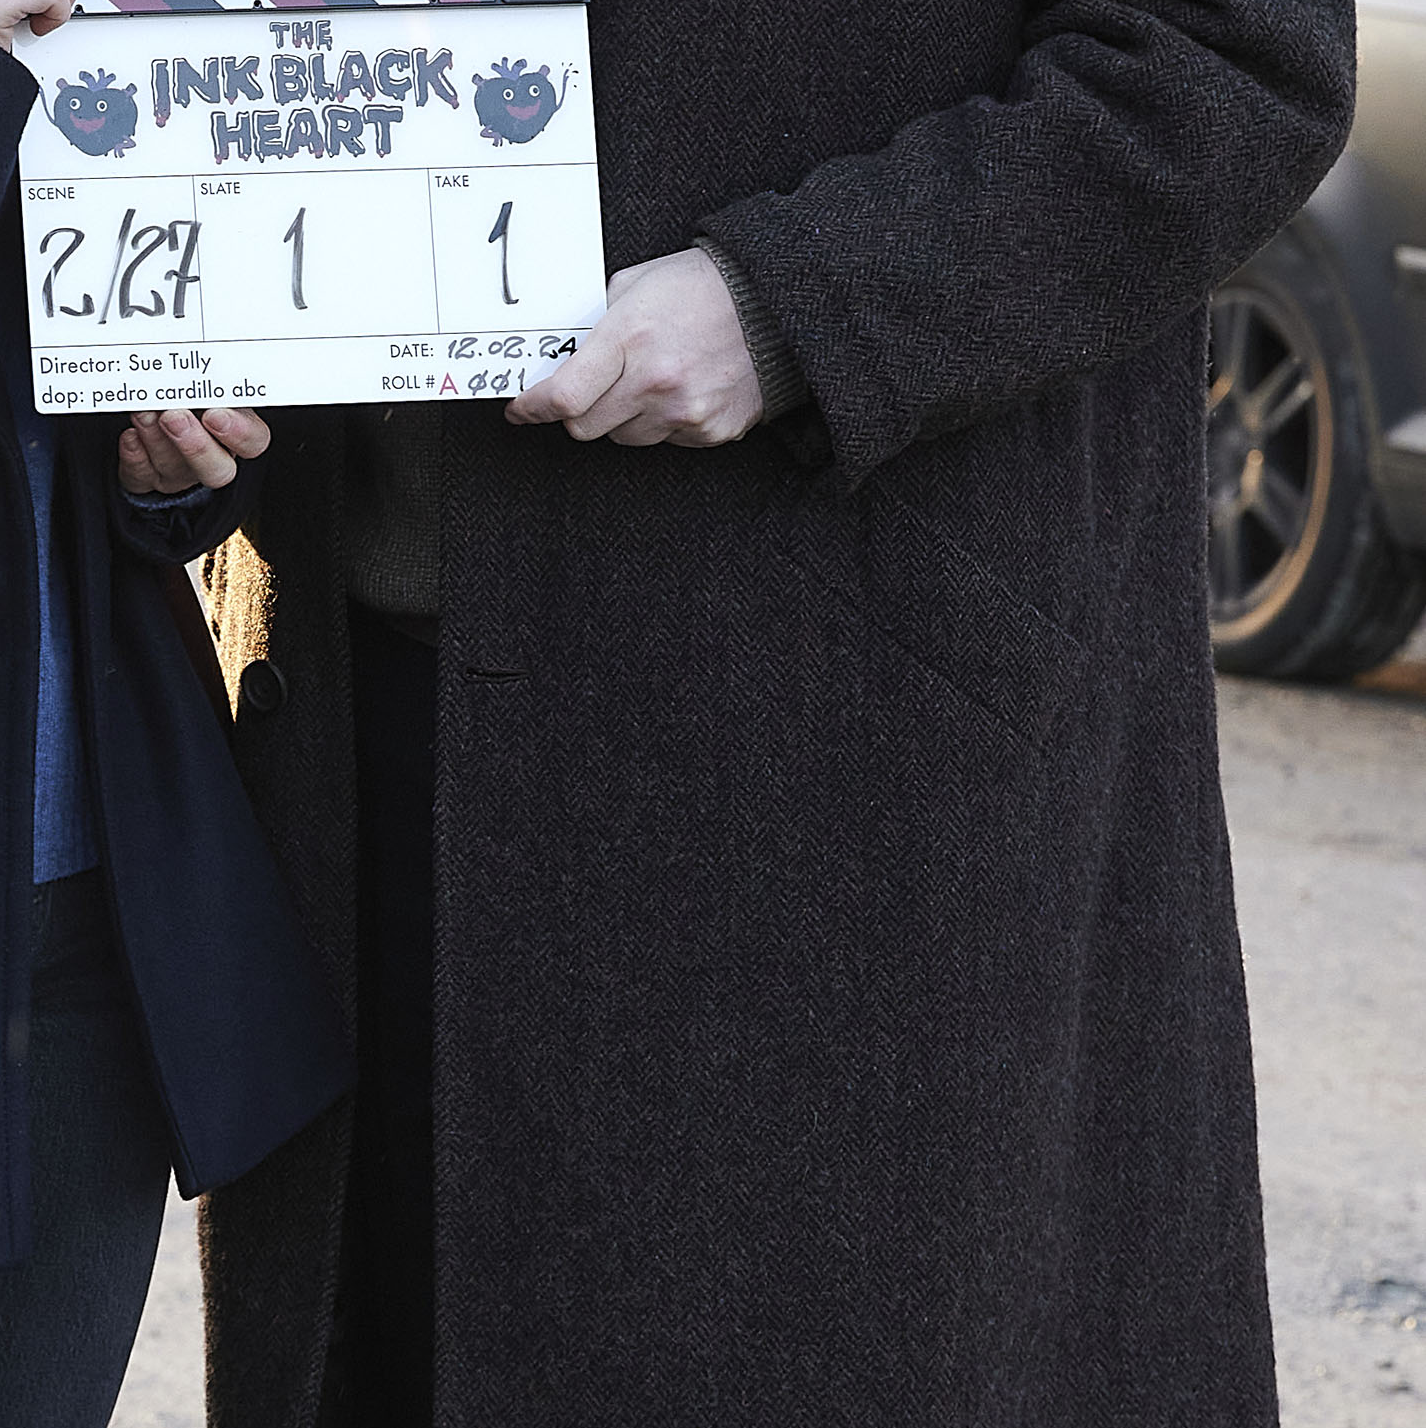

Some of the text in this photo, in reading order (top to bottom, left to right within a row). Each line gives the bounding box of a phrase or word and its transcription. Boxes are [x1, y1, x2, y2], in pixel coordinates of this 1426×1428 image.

[269, 19, 333, 51] THE
[150, 47, 459, 127] INK BLACK
[210, 105, 404, 164] HEART
[27, 185, 76, 201] SCENE
[200, 180, 242, 196] SLATE
[434, 174, 470, 189] TAKE
[39, 208, 202, 325] 2/27
[283, 207, 309, 310] 1
[488, 201, 520, 305] 1
[389, 343, 434, 359] DATE:
[447, 335, 578, 360] 12.02.24
[39, 350, 212, 374] Director: Sue Tully
[41, 378, 267, 409] dop: pedro cardillo abc
[381, 375, 421, 390] ROLL
